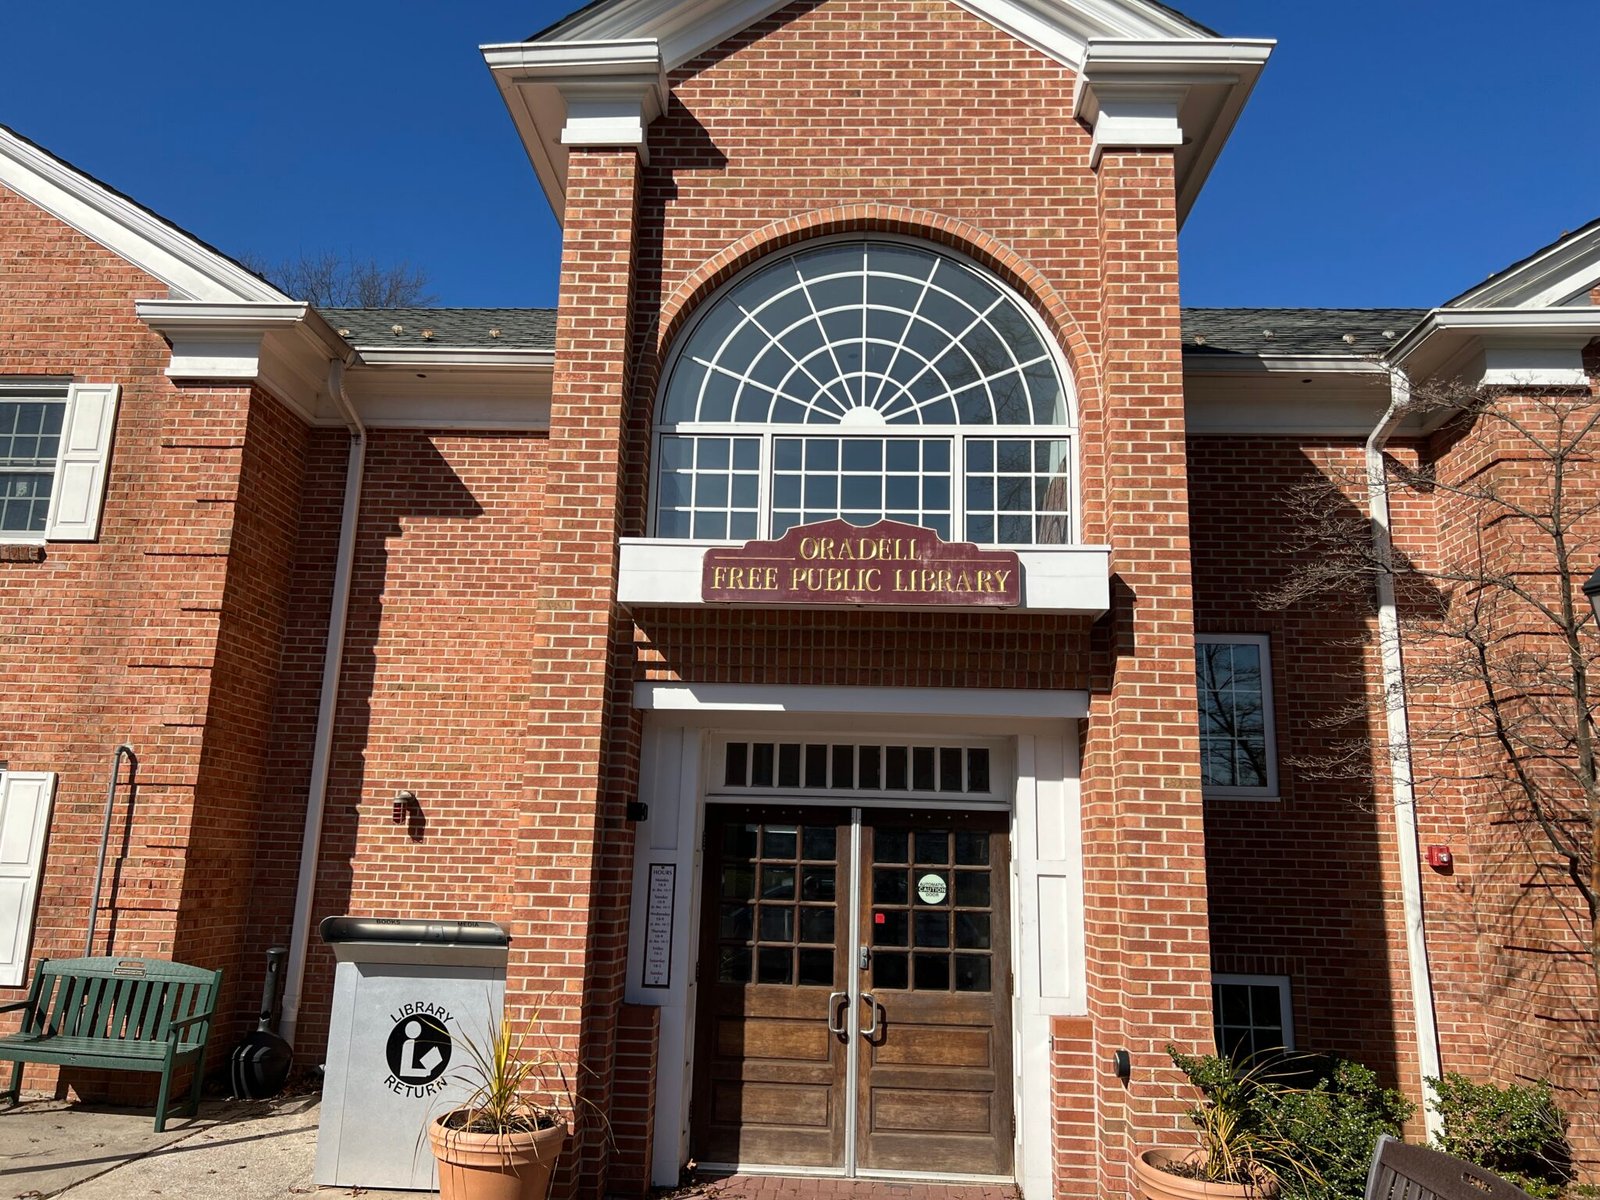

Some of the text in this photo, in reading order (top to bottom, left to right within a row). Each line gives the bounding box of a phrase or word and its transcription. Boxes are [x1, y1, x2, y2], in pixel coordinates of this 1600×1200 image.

[799, 536, 923, 561] ORADELL
[710, 566, 1012, 594] FREE PUBLIC LIBRARY
[390, 1001, 454, 1024] LIBRARY
[383, 1074, 449, 1099] RETURN
